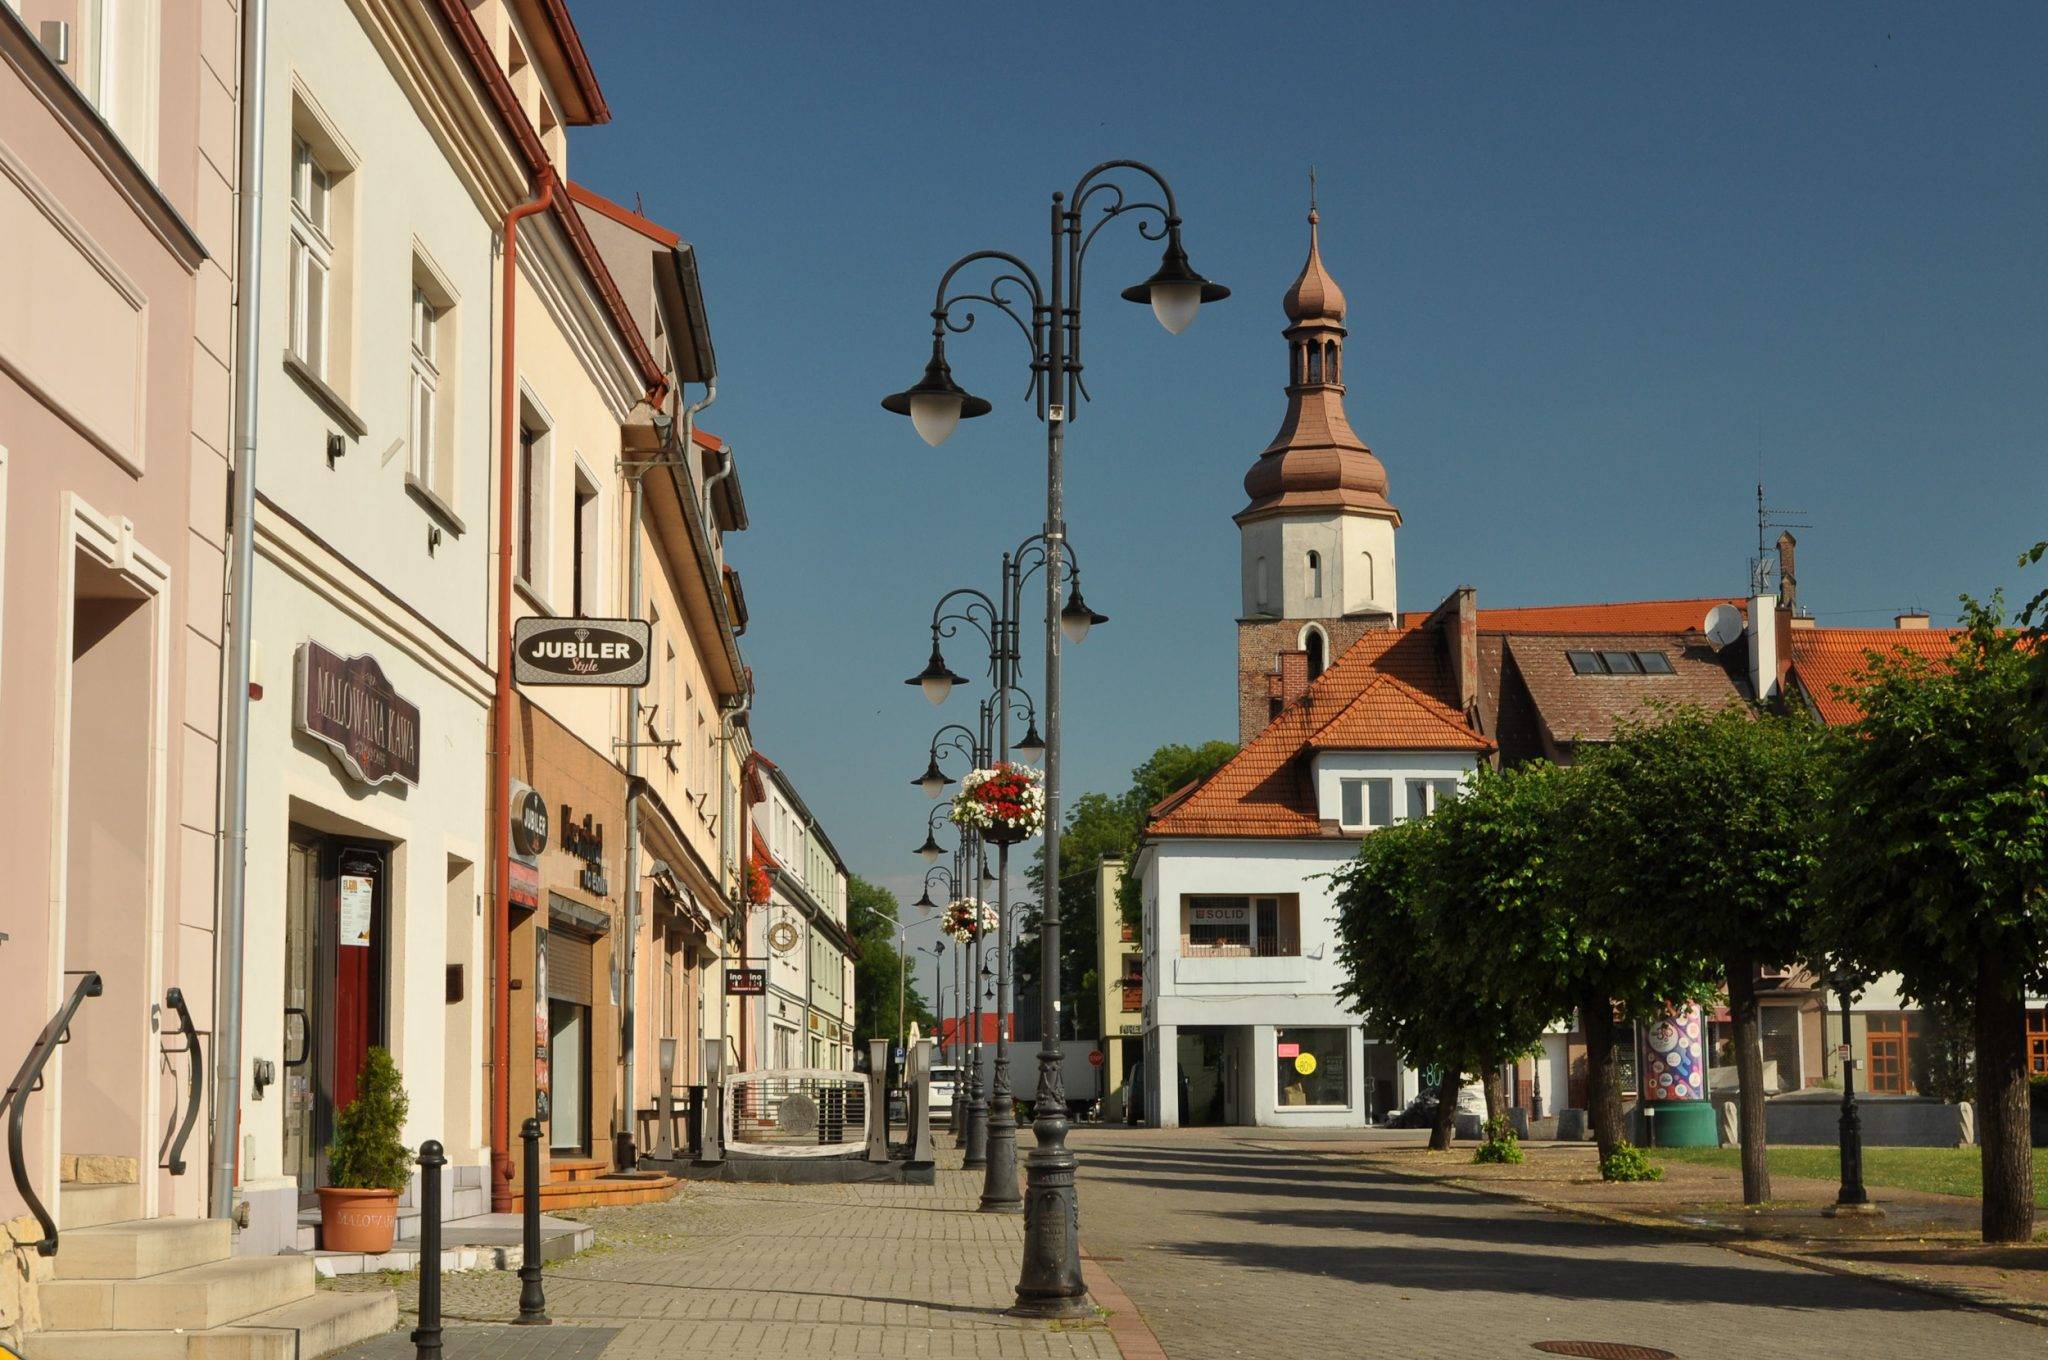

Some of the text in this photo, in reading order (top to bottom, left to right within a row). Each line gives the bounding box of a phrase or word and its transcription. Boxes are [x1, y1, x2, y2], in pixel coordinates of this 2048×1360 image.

[532, 641, 630, 659] JUBILER
[568, 656, 599, 673] Style
[316, 667, 416, 766] MALOWANA KAWA
[1207, 909, 1244, 919] SOLID
[896, 1049, 903, 1057] P
